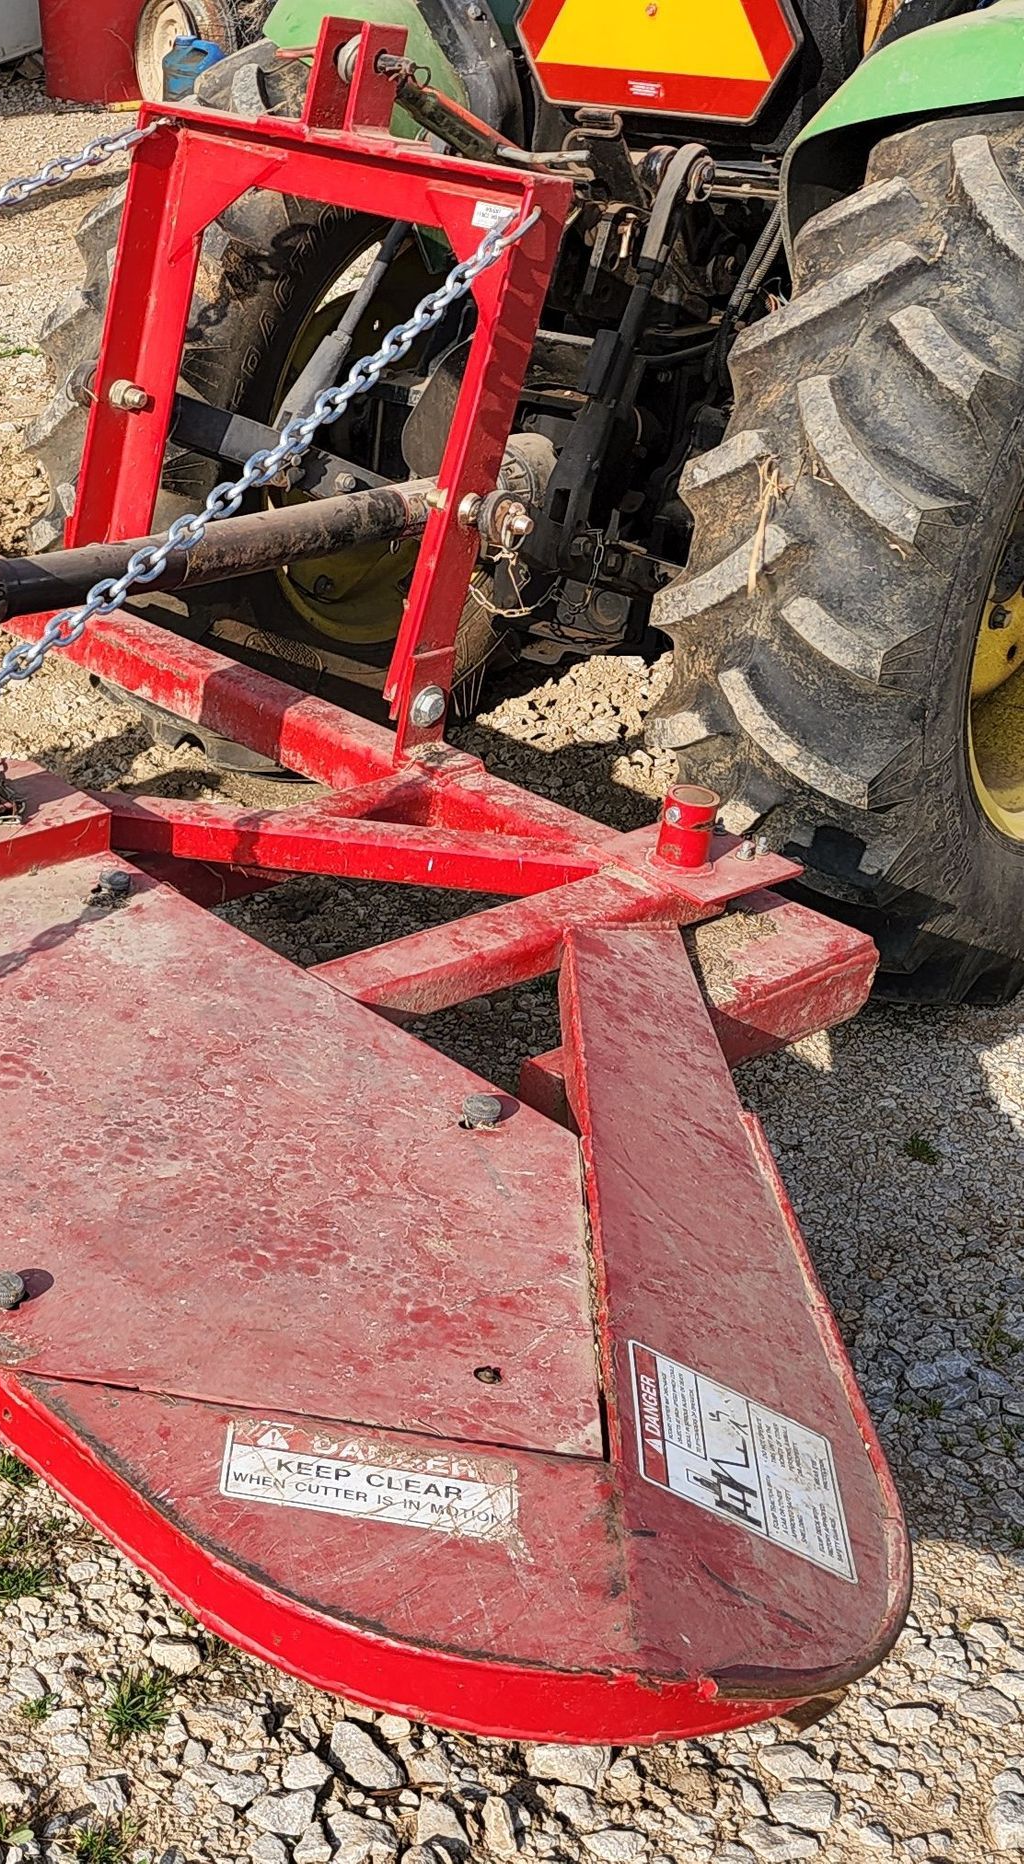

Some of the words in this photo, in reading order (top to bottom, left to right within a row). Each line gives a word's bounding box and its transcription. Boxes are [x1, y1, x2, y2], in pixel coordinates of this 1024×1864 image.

[229, 203, 360, 411] TRACTIO
[639, 1372, 660, 1437] DANGER
[233, 1471, 286, 1489] WHEN
[295, 1481, 368, 1503] CUTTER
[378, 1494, 393, 1506] IS
[404, 1498, 420, 1511] IN
[277, 1458, 351, 1481] KEEP
[366, 1473, 462, 1500] CLEAR
